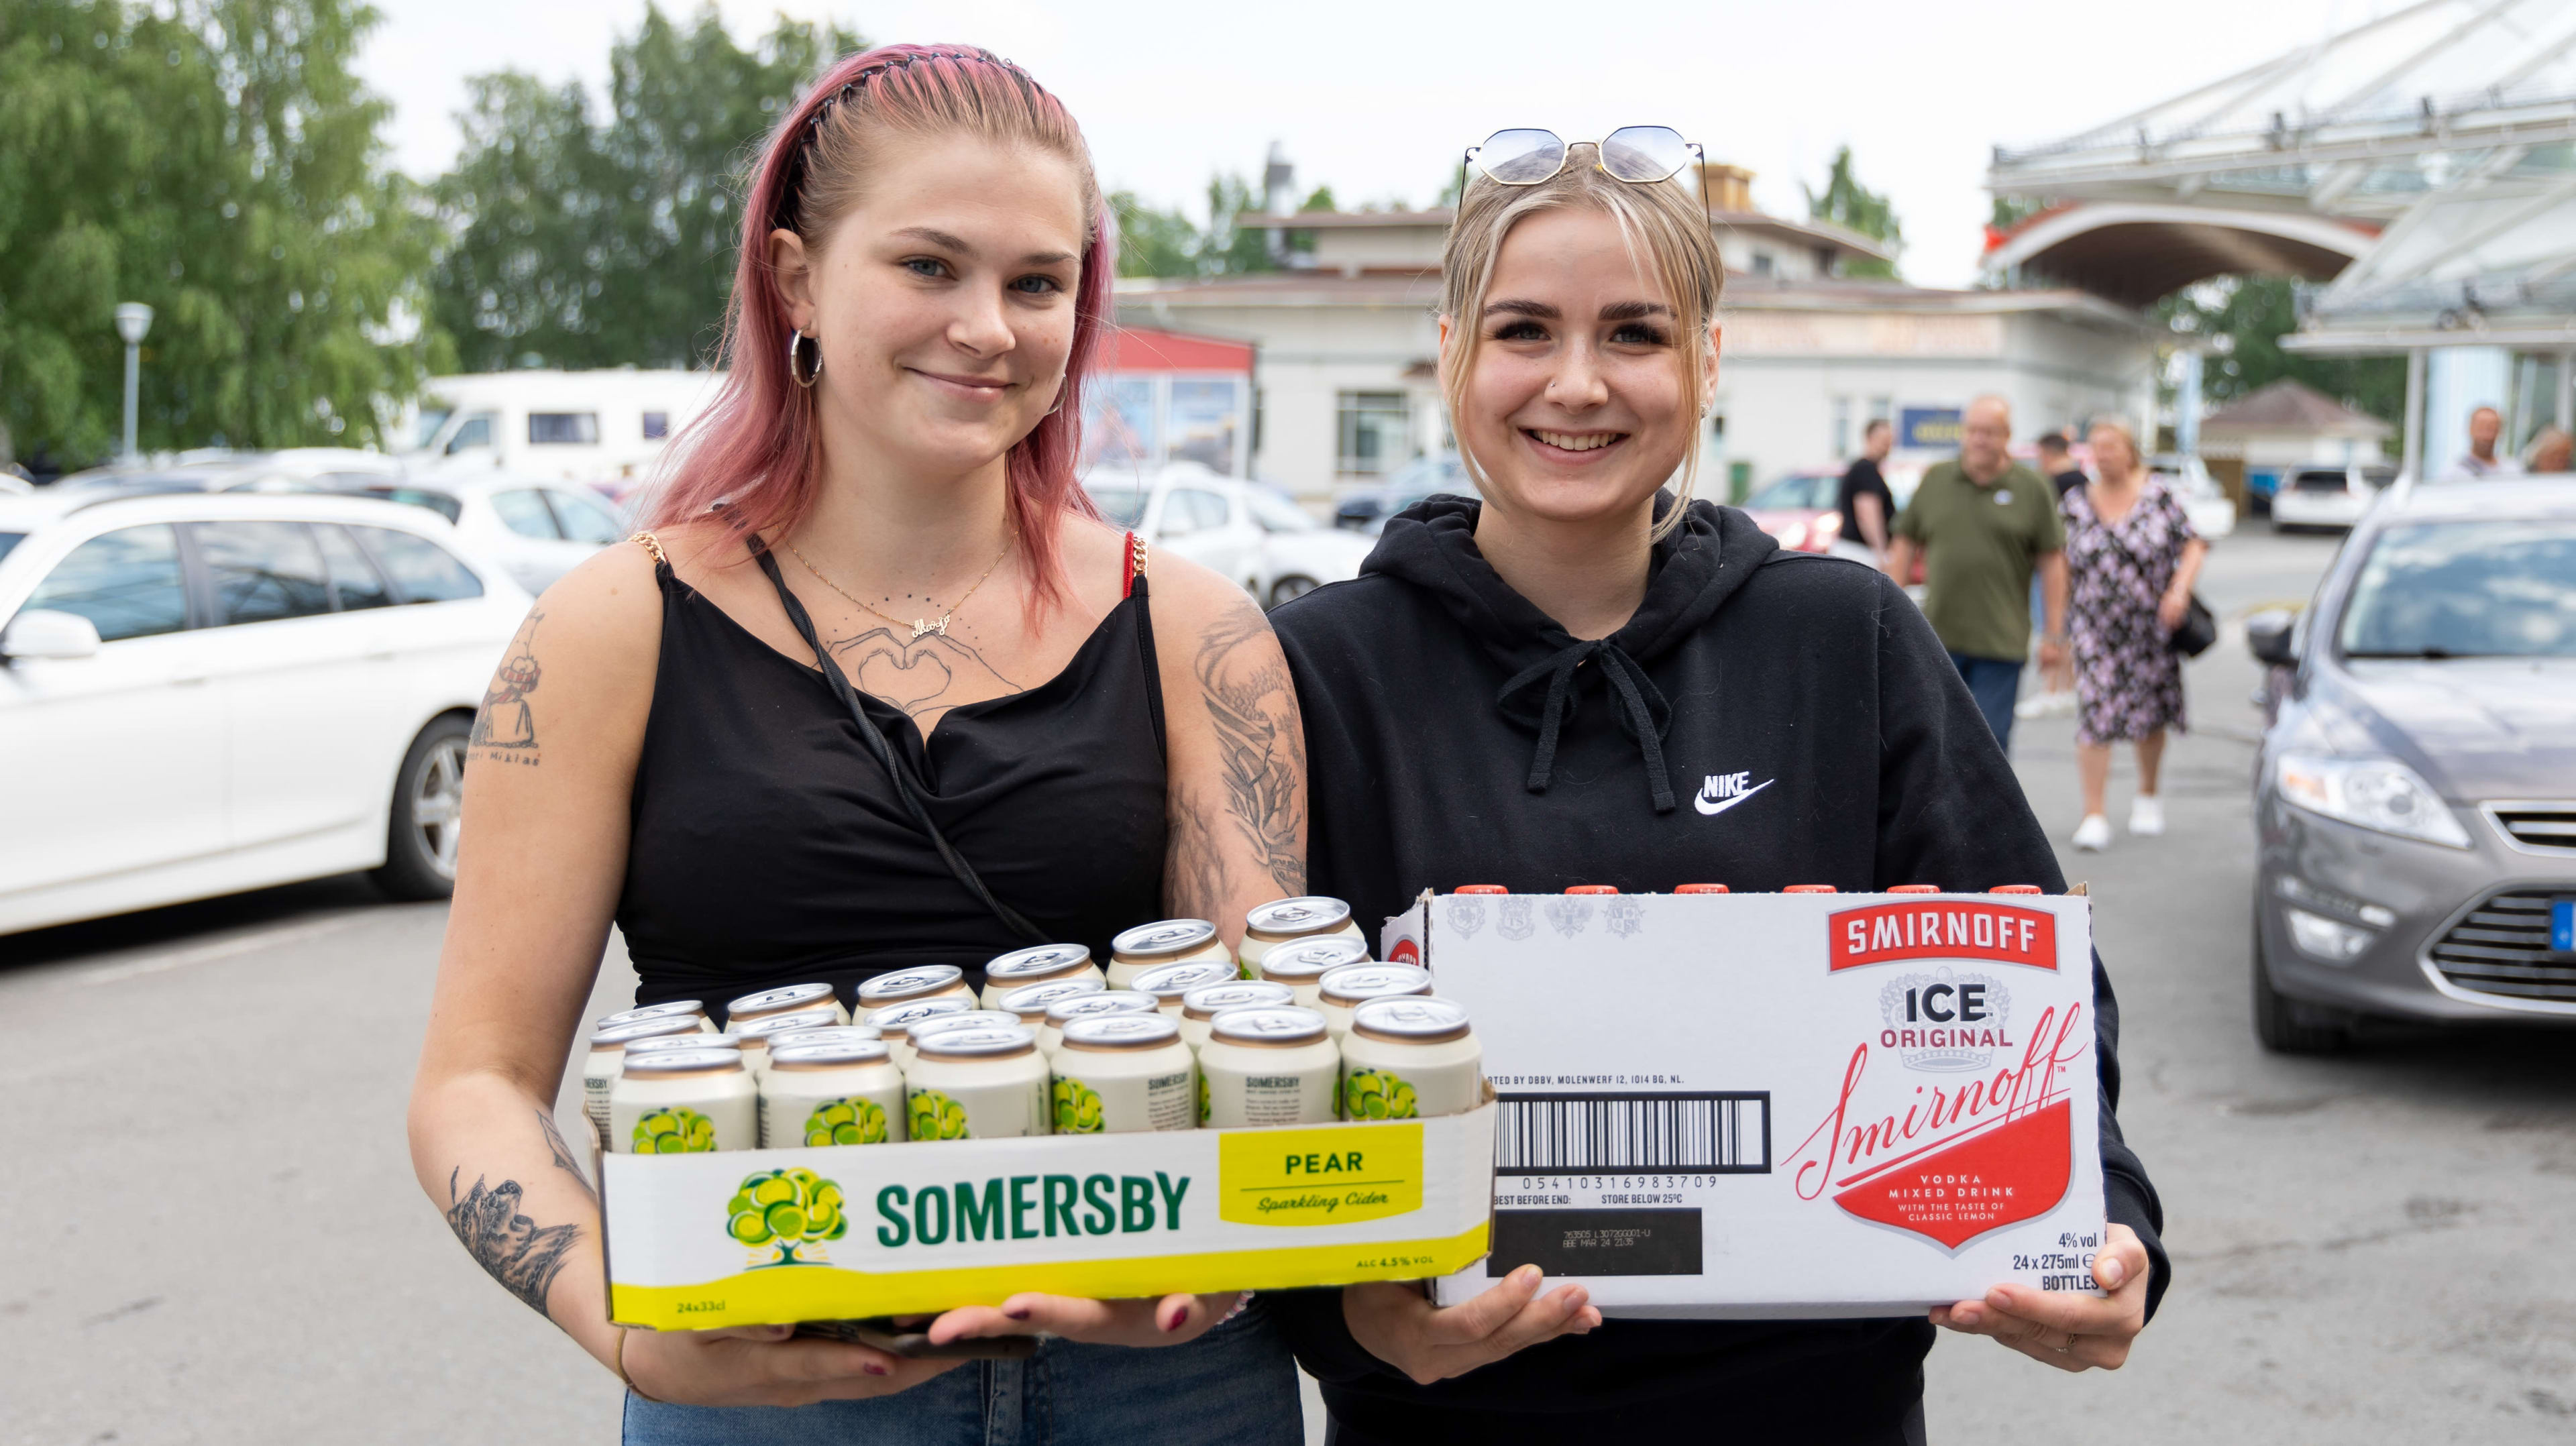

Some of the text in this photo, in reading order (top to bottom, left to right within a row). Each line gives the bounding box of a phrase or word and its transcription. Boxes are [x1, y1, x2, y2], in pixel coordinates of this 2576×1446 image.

[1703, 771, 1750, 797] NIKE
[1847, 911, 2037, 955] SMIRNOFF
[1906, 983, 1986, 1023] ICE
[1880, 1028, 2013, 1048] ORIGINAL
[1513, 1076, 1525, 1084] BY
[1557, 1075, 1613, 1084] MOLENWERF
[1631, 1074, 1650, 1084] 1014
[1670, 1074, 1684, 1084] NL.
[1780, 1001, 2089, 1201] Smirnoff
[1285, 1151, 1364, 1175] PEAR
[1920, 1174, 1981, 1184] VODKA
[1493, 1194, 1571, 1205] BEST BEFORE END:
[1601, 1194, 1630, 1204] STORE
[1631, 1194, 1661, 1204] BELOW
[1889, 1187, 2013, 1199] MIXED DRINK
[876, 1170, 1192, 1248] SOMERSBY
[1257, 1191, 1389, 1215] Sparkling Cider
[1898, 1203, 1925, 1211] WITH
[1955, 1203, 1985, 1211] TASTE
[1991, 1202, 2004, 1210] OF
[1908, 1212, 1994, 1221] CLASSIC LEMON
[1580, 1239, 1597, 1247] MAR
[1600, 1238, 1611, 1247] 24
[2058, 1232, 2097, 1248] 4% vol
[1356, 1256, 1434, 1268] ALC 4.5% VOL
[2012, 1254, 2079, 1270] 24 x 275ml
[2042, 1274, 2099, 1291] BOTTLES
[677, 1299, 726, 1314] 24x33cl
